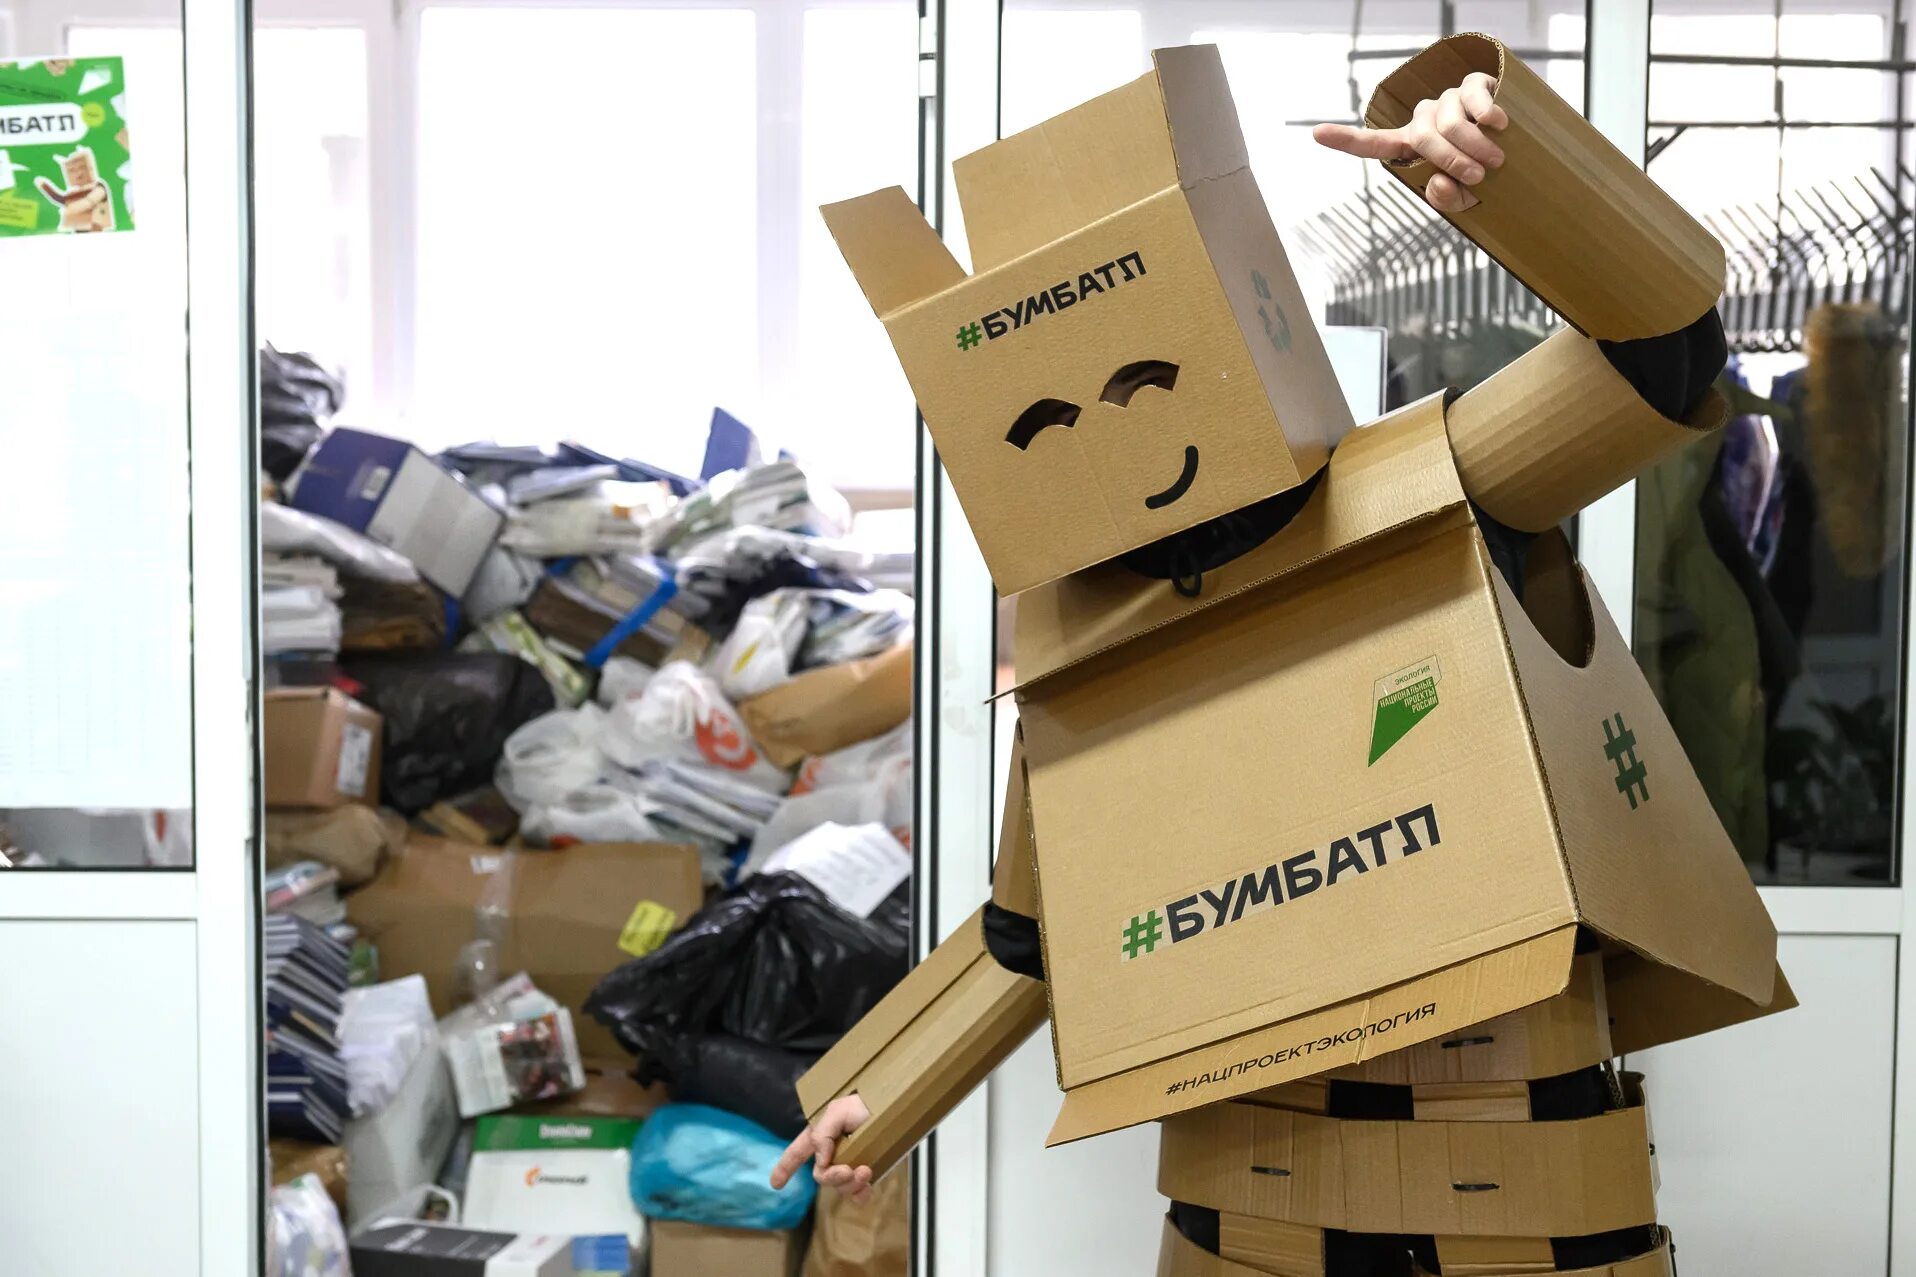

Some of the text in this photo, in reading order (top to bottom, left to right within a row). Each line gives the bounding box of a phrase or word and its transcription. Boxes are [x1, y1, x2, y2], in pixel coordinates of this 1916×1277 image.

[956, 251, 1147, 351] #БУМБАТЛ
[1380, 679, 1434, 708] НАЦИОНАЛЬНЫЕ
[1404, 687, 1436, 708] ПРОЕКТЫ
[1411, 695, 1438, 713] РОССИИ
[1121, 803, 1441, 959] #БУМБАТЛ
[1165, 1002, 1436, 1095] #НАЦПРОЕКТЭКОЛОГИЯ
